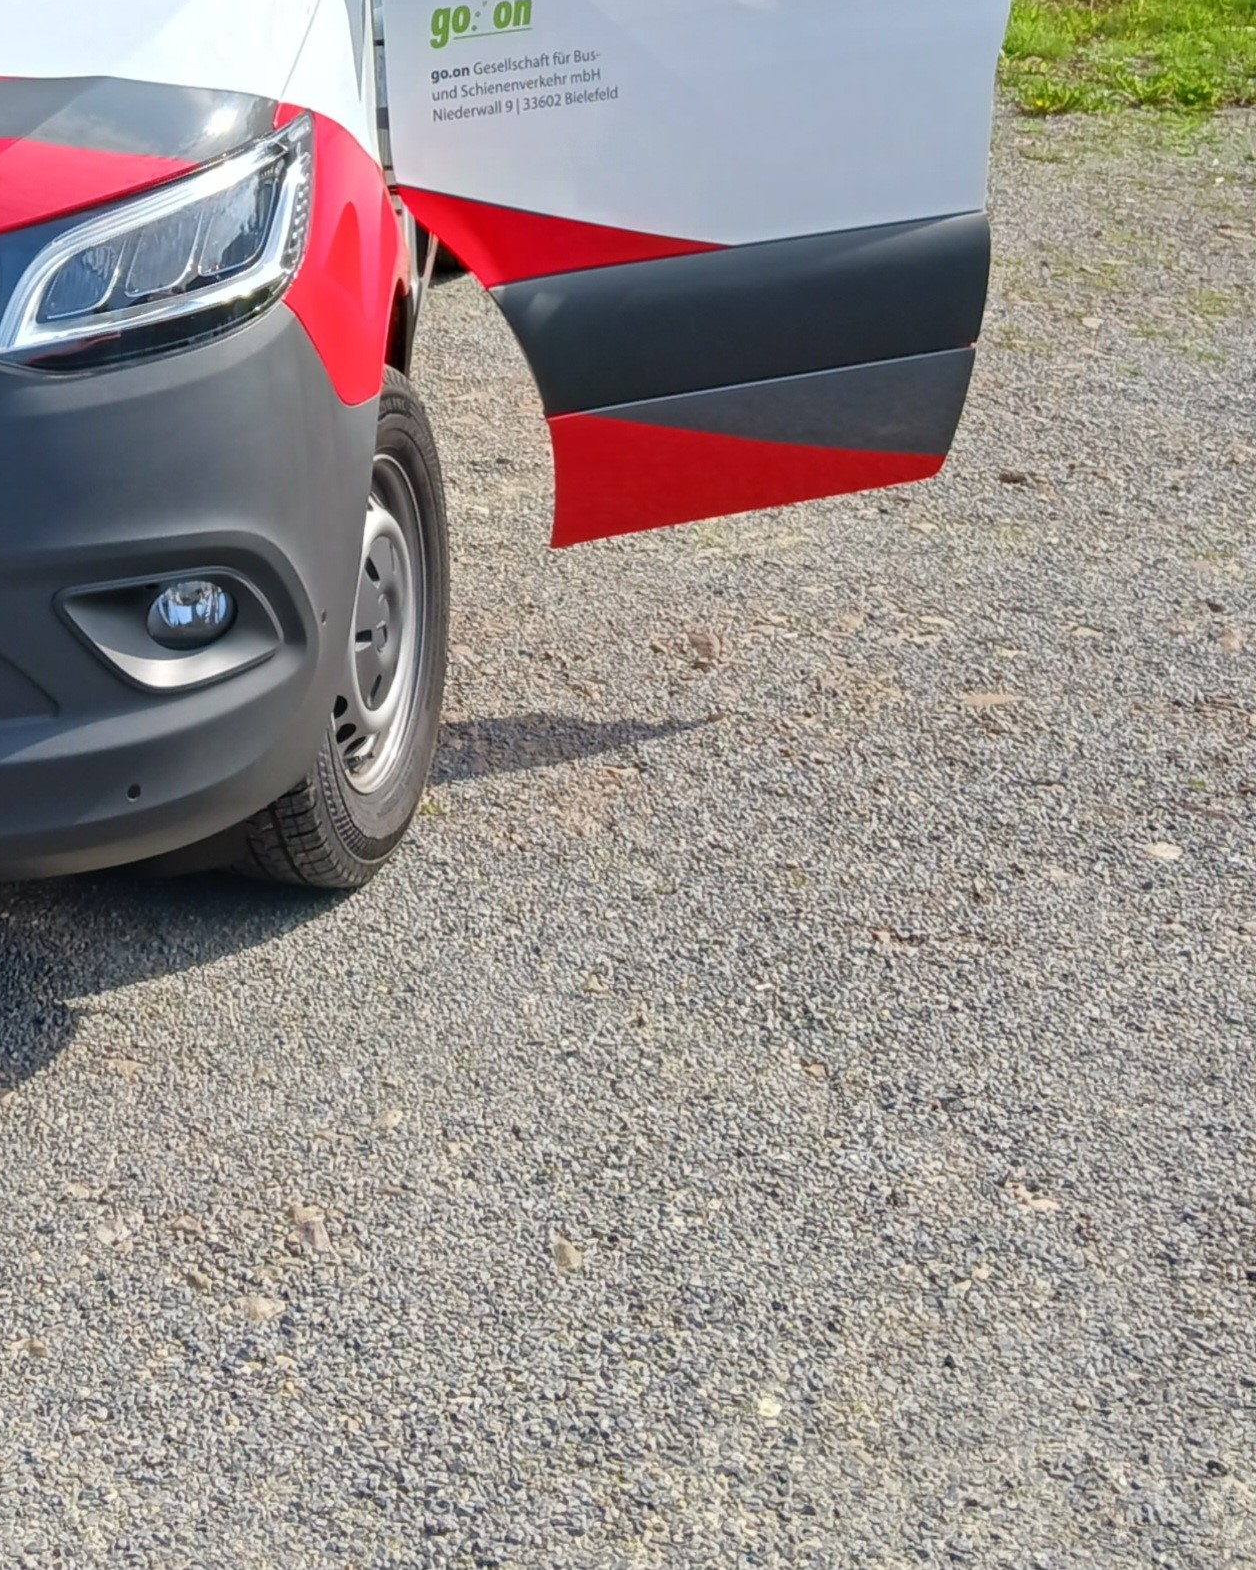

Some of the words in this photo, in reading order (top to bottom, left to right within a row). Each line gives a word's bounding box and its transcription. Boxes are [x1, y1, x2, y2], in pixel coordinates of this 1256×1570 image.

[430, 65, 470, 84] go.on
[473, 51, 550, 76] Gesellschaft
[552, 51, 571, 66] für
[573, 49, 601, 64] Bus-
[432, 85, 458, 102] und
[460, 73, 567, 99] Schienenverkehr
[570, 68, 602, 85] mbH
[432, 100, 503, 122] Niederwall
[505, 100, 514, 113] 9
[523, 93, 562, 112] 33602
[565, 86, 619, 106] Bielefeld
